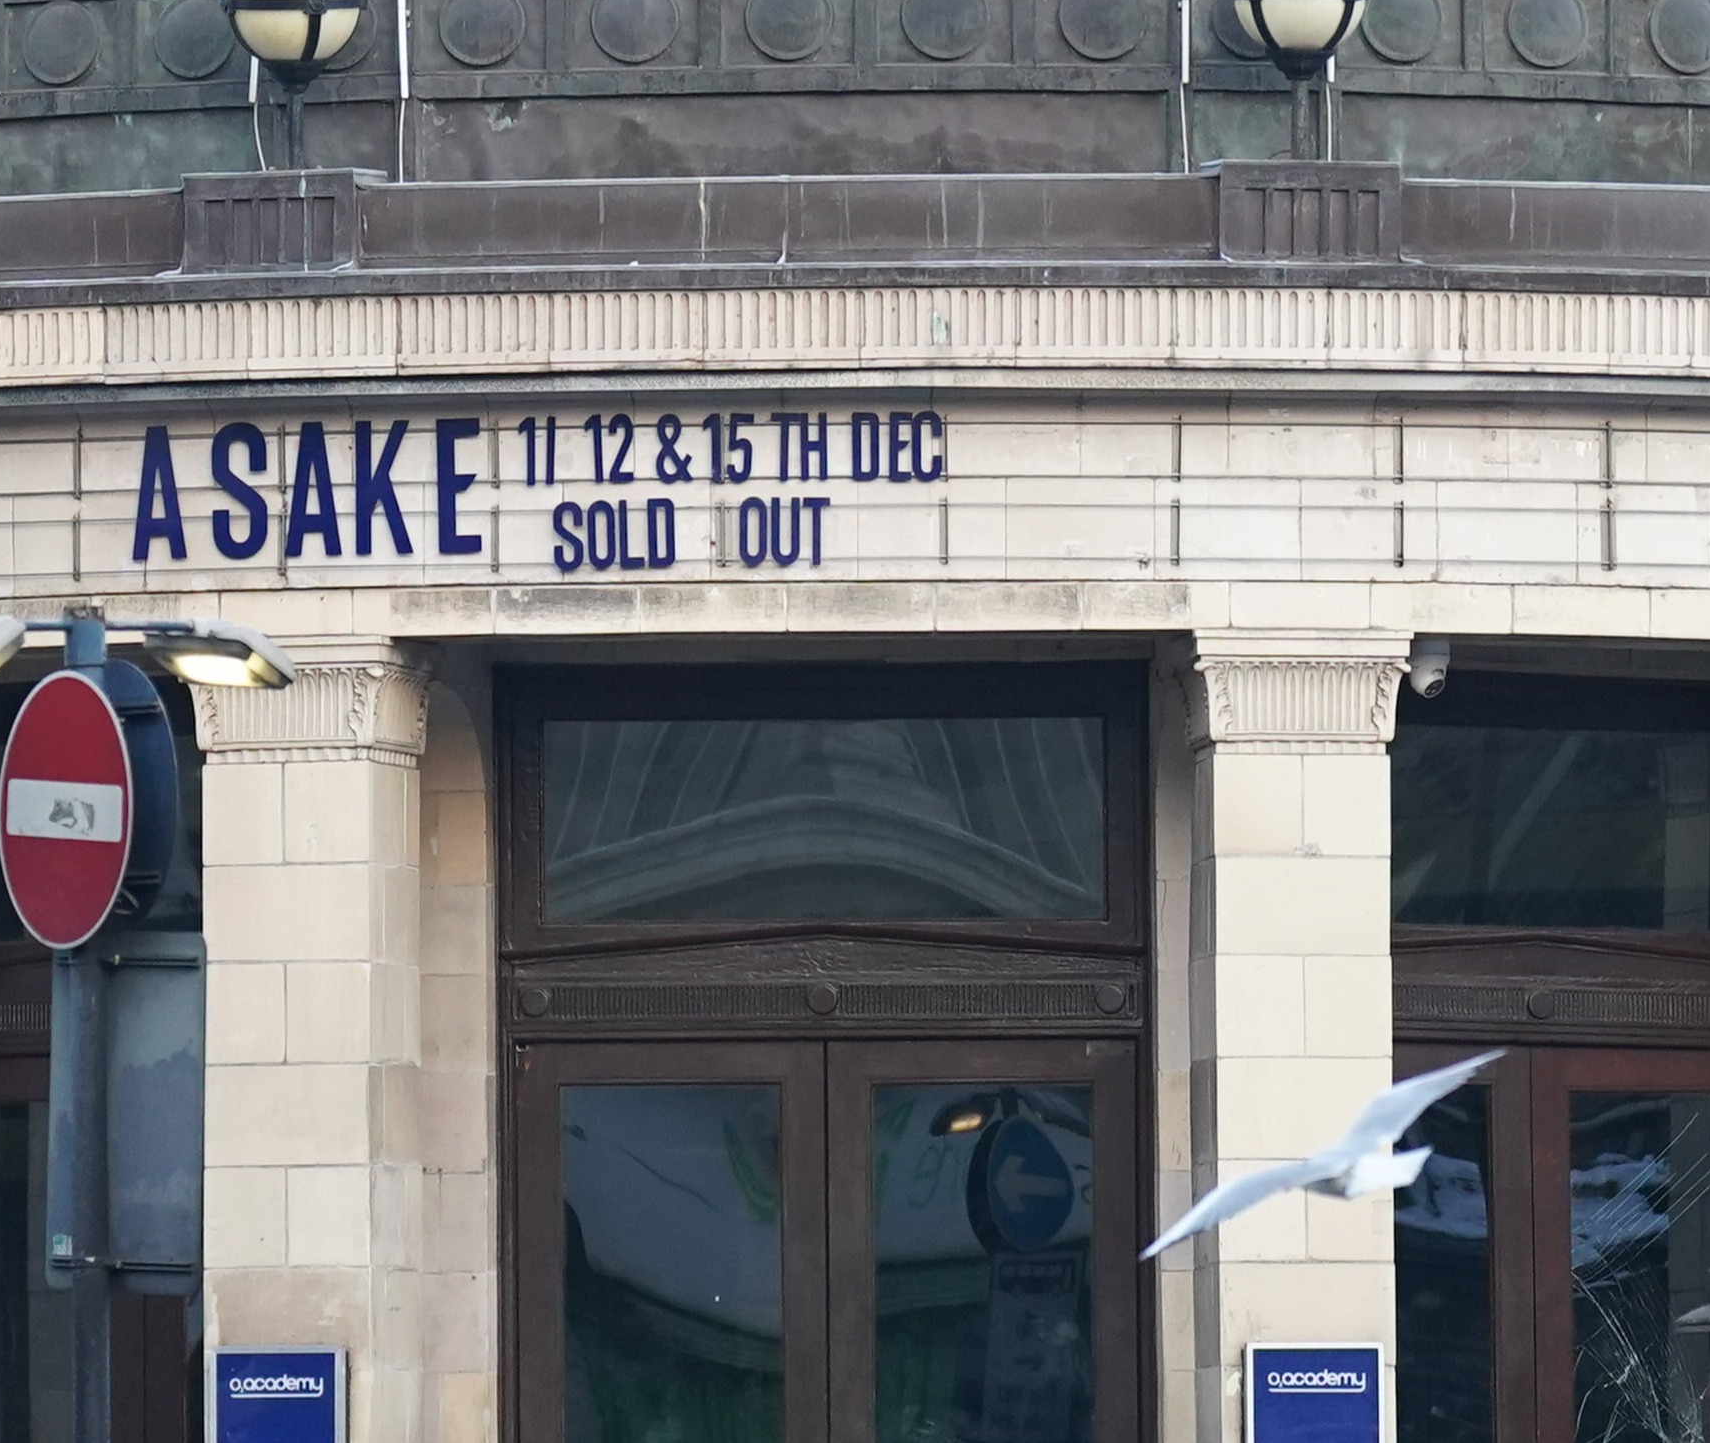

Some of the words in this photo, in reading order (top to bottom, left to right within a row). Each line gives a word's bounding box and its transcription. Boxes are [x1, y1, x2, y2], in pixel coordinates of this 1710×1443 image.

[584, 412, 635, 484] 12
[851, 410, 944, 483] DEC
[132, 417, 483, 562] ASAKE
[553, 497, 676, 572] SOLD
[738, 496, 831, 569] OUT
